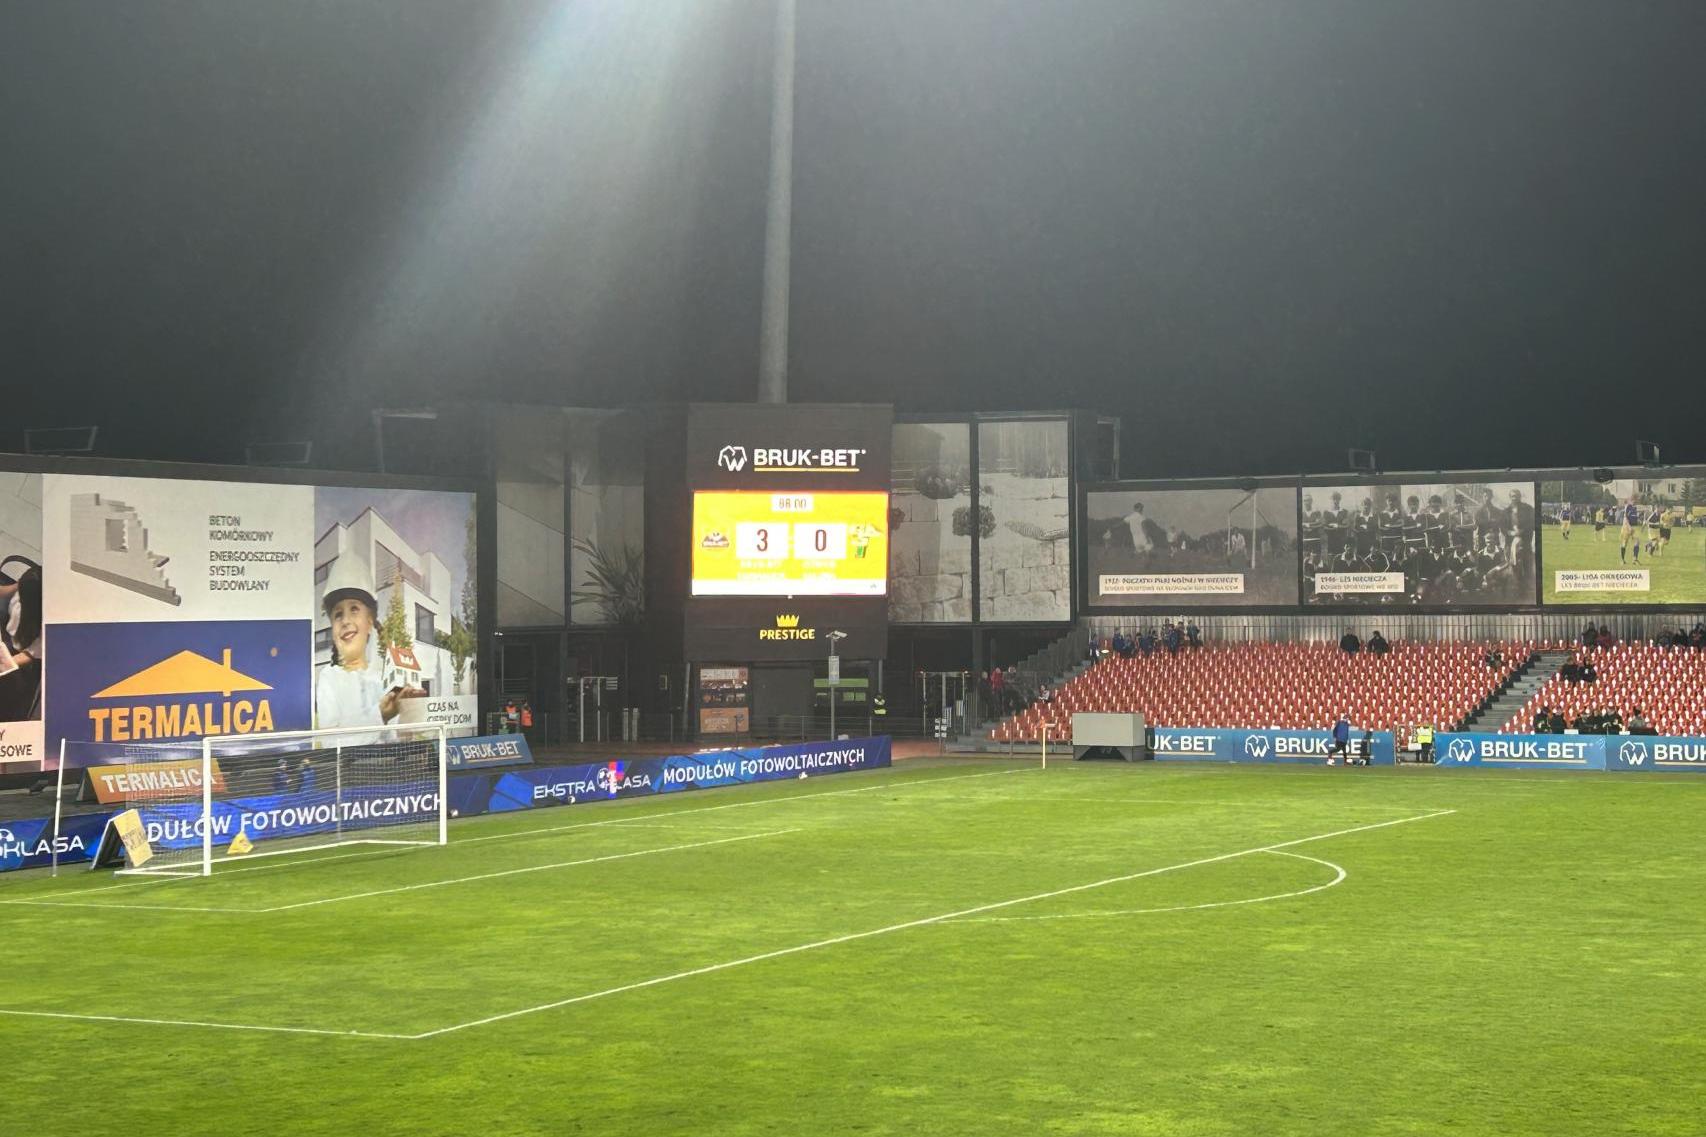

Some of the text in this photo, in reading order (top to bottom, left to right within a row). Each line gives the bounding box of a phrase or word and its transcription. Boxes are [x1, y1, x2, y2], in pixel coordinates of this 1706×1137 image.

[754, 448, 860, 467] BRUK-BET
[209, 515, 241, 526] BETON
[756, 528, 769, 552] 3
[814, 528, 828, 552] 0
[209, 565, 245, 576] SYSTEM
[209, 580, 270, 591] BUDOWLANY
[759, 628, 816, 640] PRESTIGE
[448, 701, 460, 712] NA
[89, 699, 275, 742] TERMALICA
[461, 741, 521, 760] BRUK-BET
[1275, 737, 1375, 754] BRUK-E
[1481, 740, 1586, 759] BRUK-BET
[663, 748, 865, 785] MODUŁÓW FOTOWOLTAICZNYCH
[101, 767, 218, 794] TERMALIC
